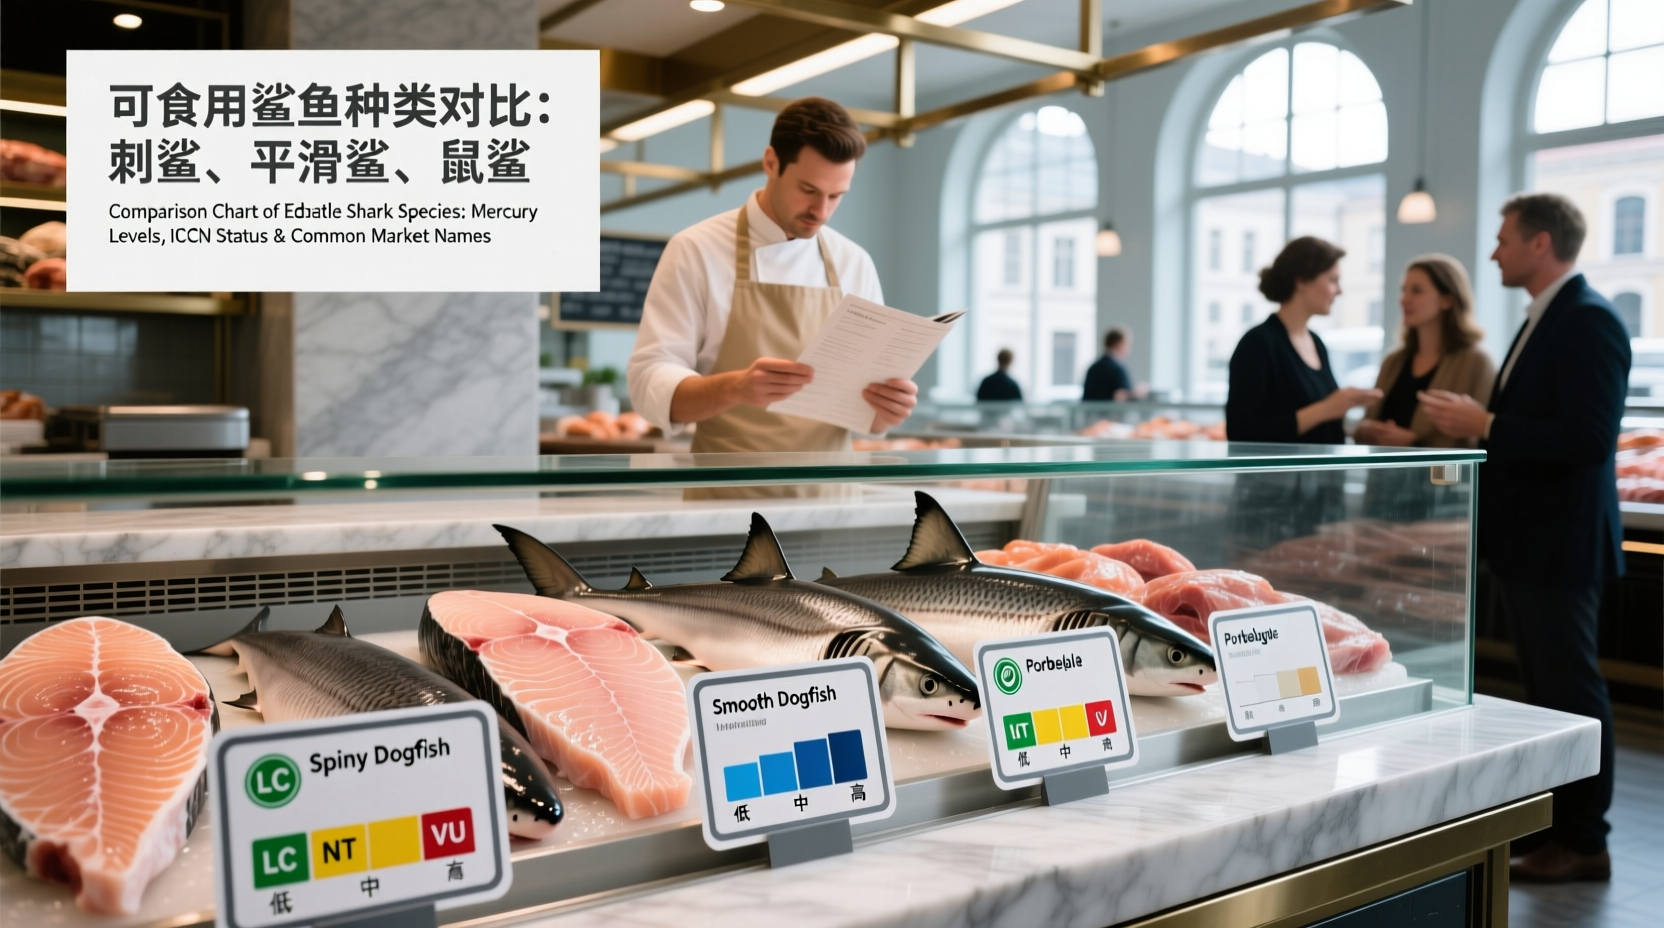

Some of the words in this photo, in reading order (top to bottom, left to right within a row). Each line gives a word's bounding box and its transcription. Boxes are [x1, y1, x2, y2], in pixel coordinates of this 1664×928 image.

[712, 692, 774, 715] Smooth
[777, 685, 837, 709] Dogfish
[310, 750, 368, 777] Spiny
[374, 737, 451, 766] Dogfish
[1059, 743, 1071, 759] 中
[256, 767, 291, 794] LC
[733, 804, 751, 823] 低
[793, 794, 808, 812] 中
[850, 783, 866, 803] 高
[262, 846, 298, 875] LC
[322, 837, 357, 864] NT
[430, 820, 466, 846] VU
[269, 891, 293, 916] 低
[360, 876, 380, 898] 中
